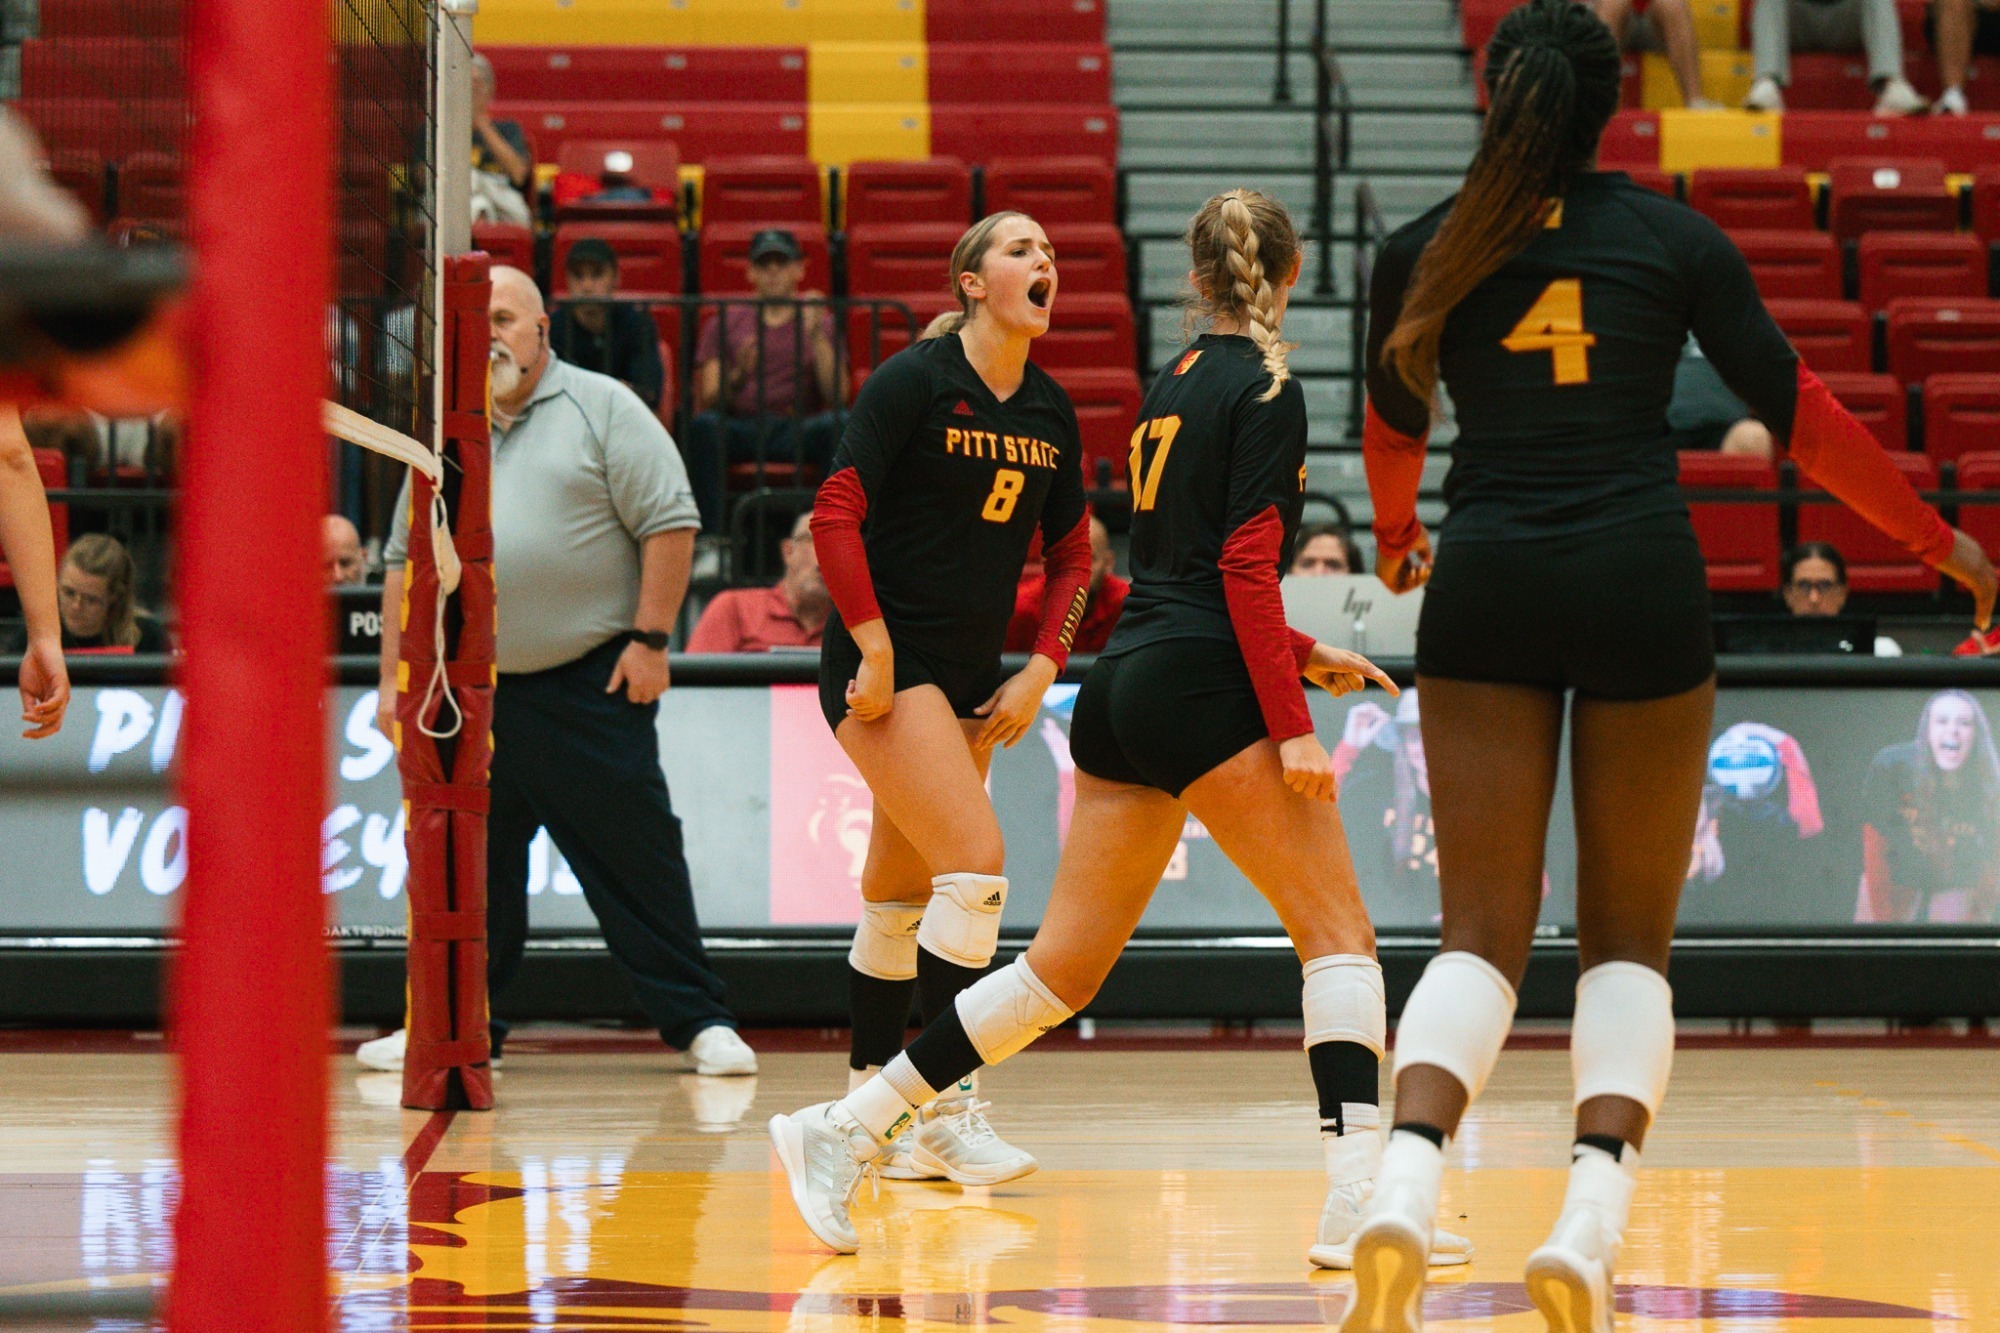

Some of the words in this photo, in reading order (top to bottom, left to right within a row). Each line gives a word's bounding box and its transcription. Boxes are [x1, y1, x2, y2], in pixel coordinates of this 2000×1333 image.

[1501, 278, 1596, 384] 4
[946, 427, 997, 460] PITT
[1003, 435, 1060, 470] STATE
[1128, 414, 1182, 513] 17
[981, 468, 1025, 523] 8
